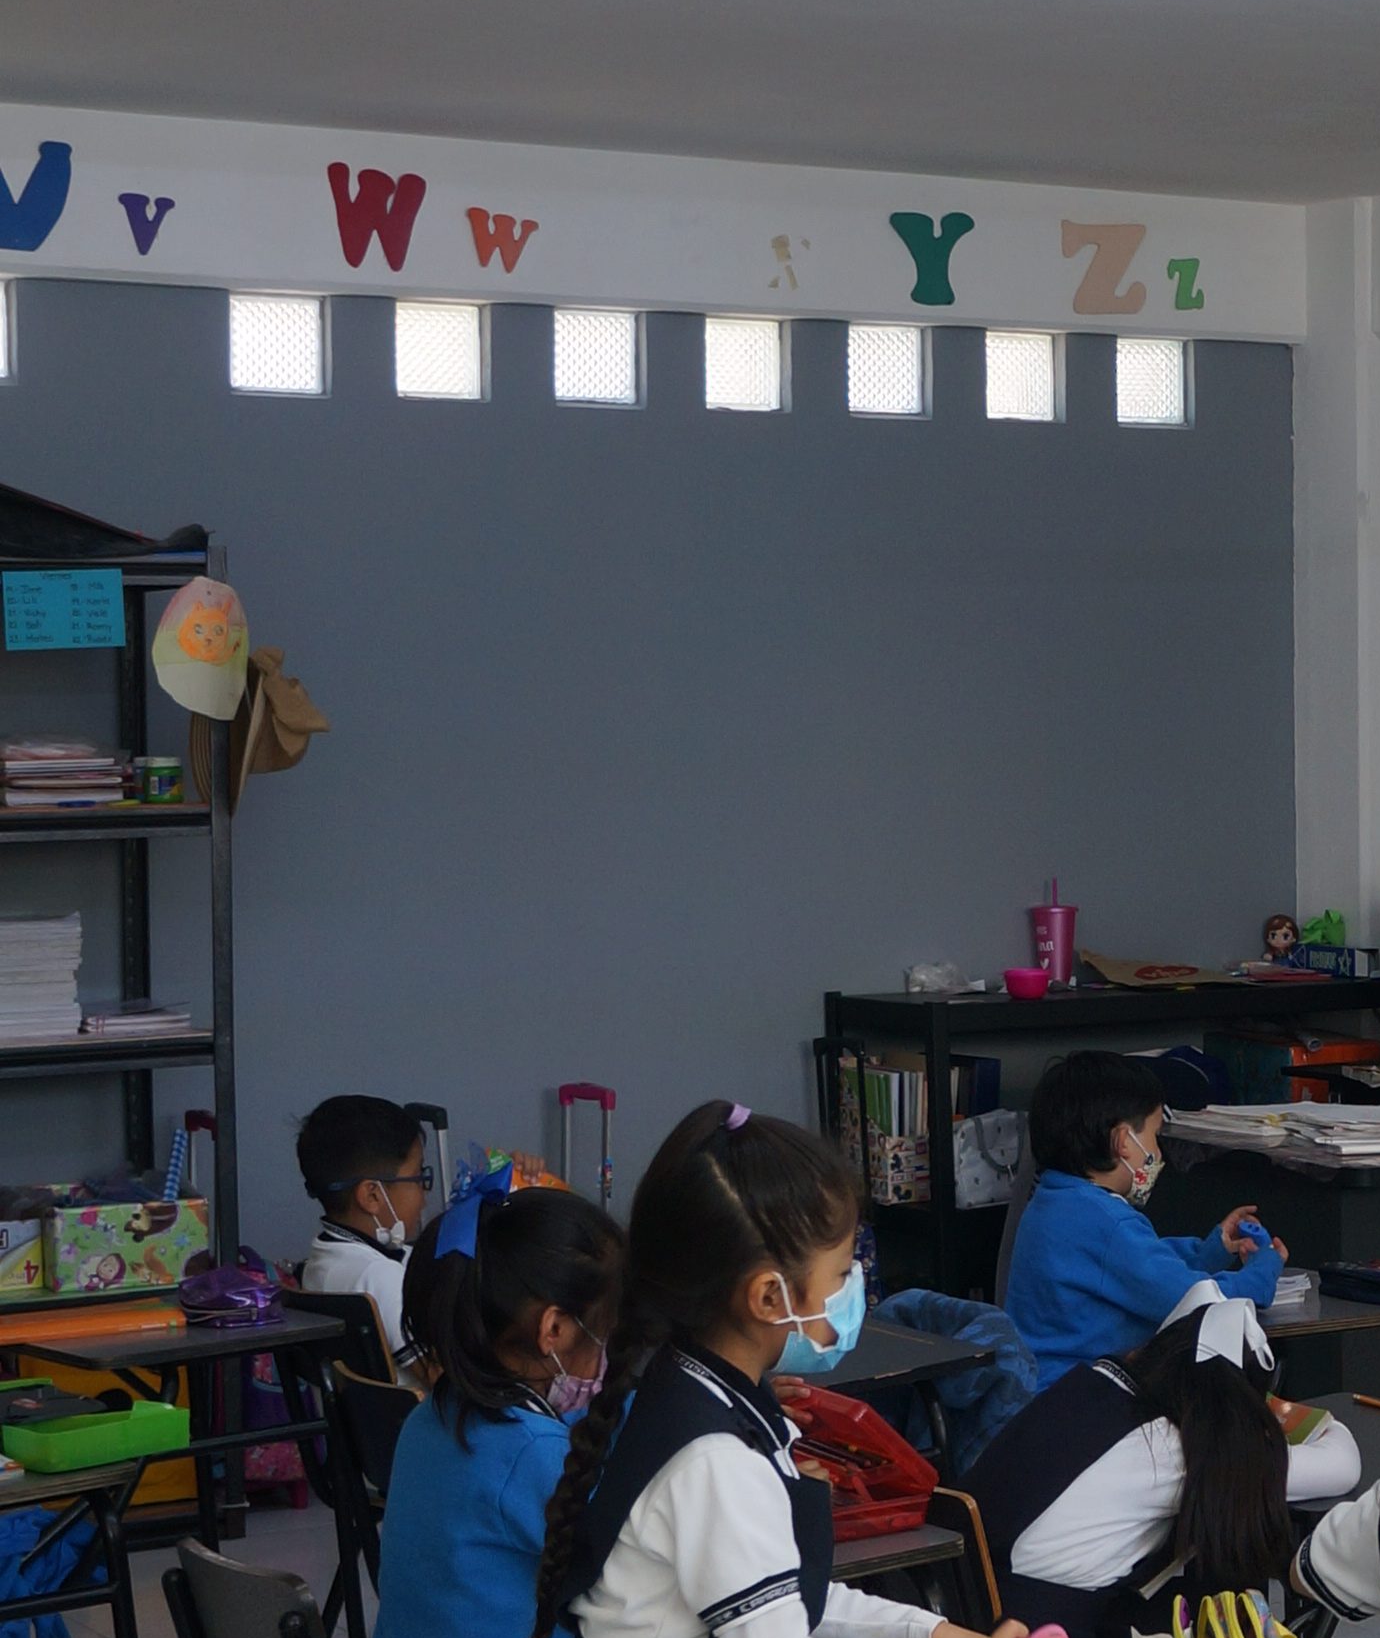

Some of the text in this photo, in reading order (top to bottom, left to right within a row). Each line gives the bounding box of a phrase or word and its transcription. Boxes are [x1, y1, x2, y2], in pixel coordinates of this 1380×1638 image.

[327, 161, 427, 272] W
[889, 212, 975, 305] Y
[1061, 220, 1147, 315] Z
